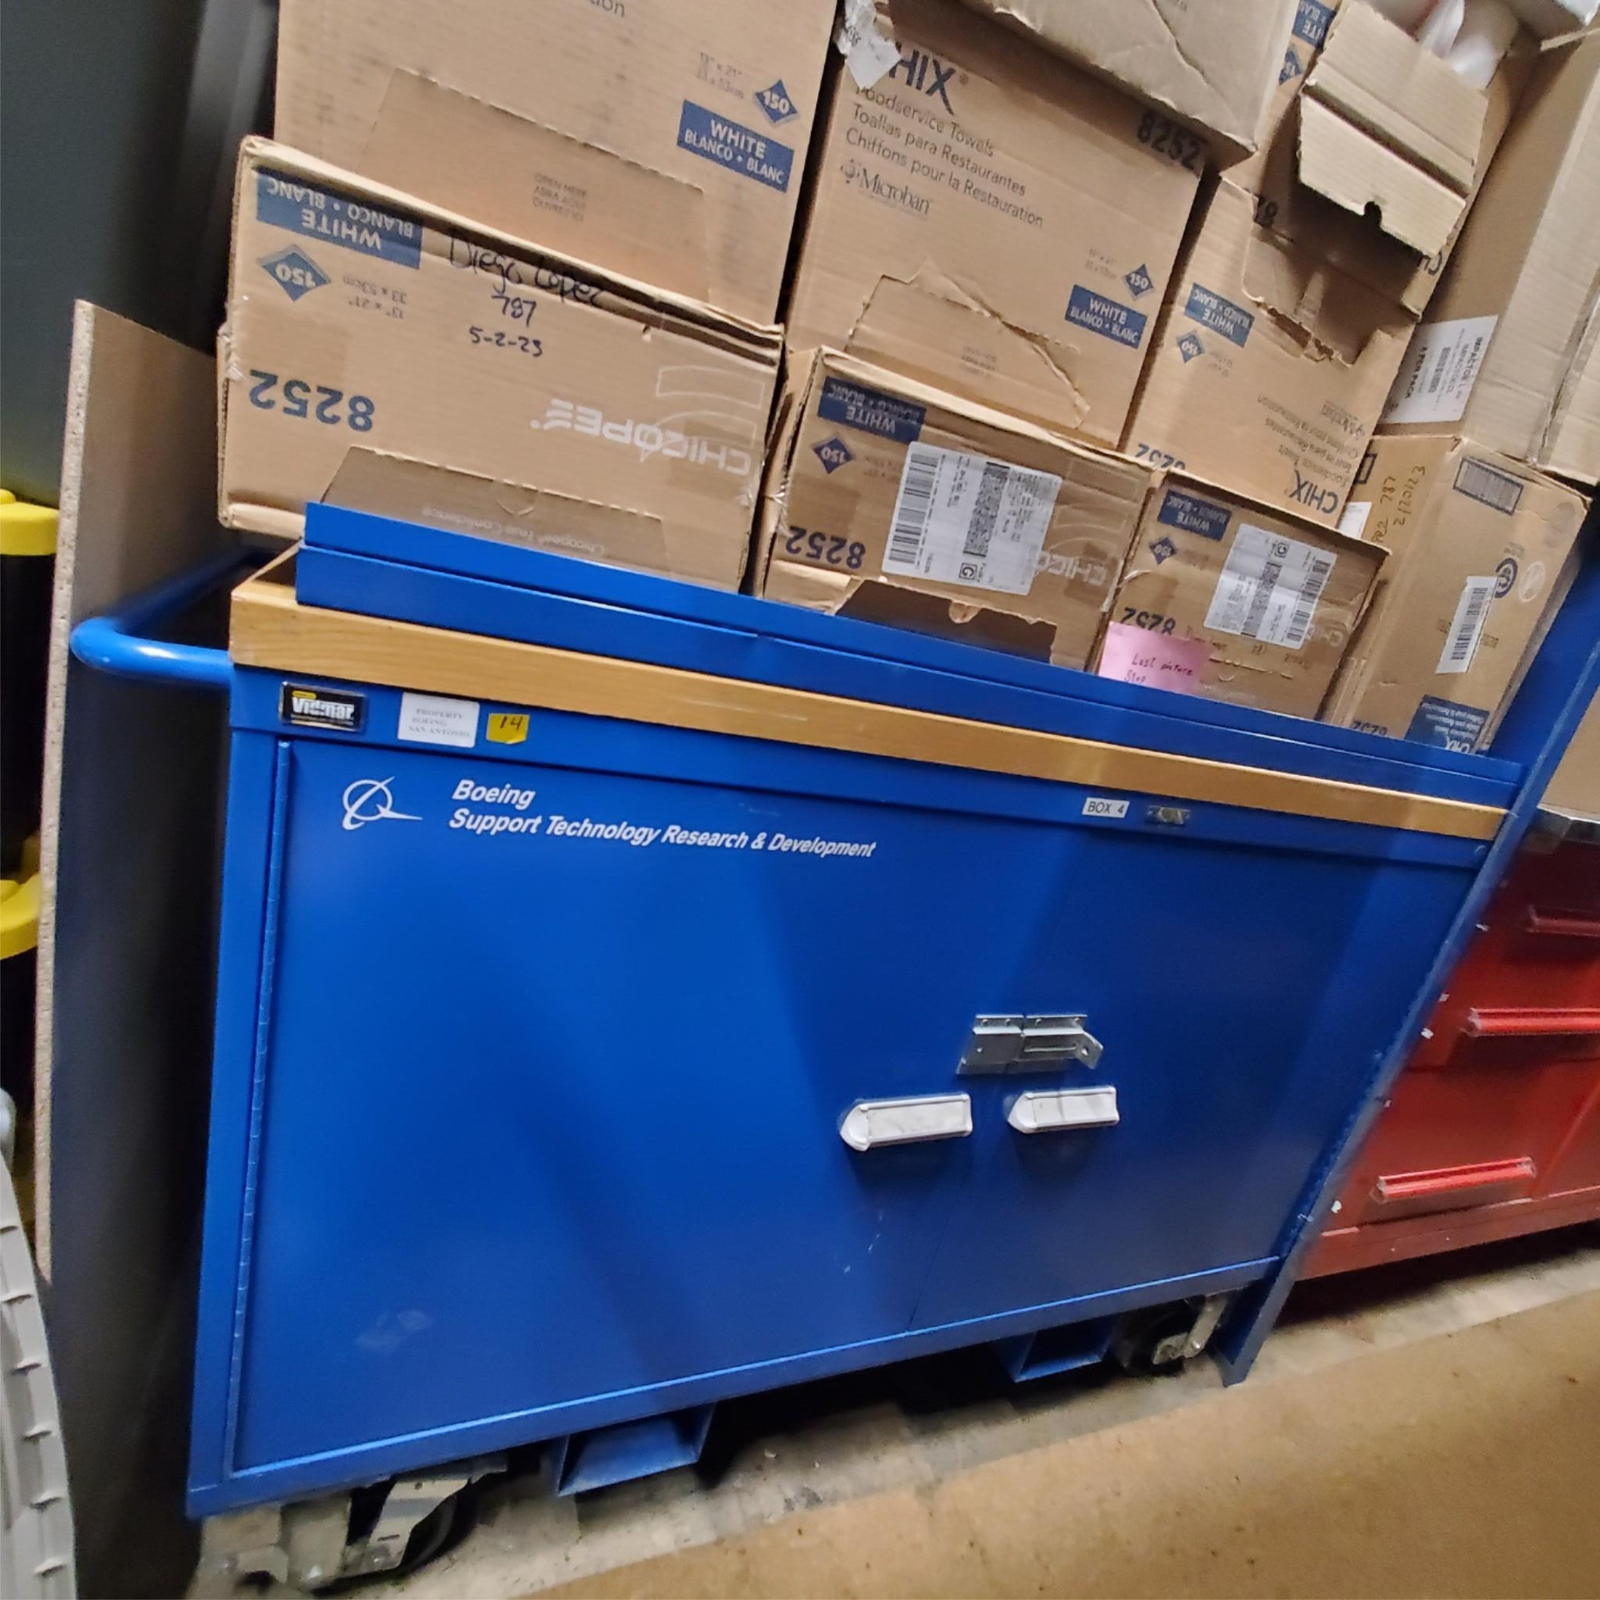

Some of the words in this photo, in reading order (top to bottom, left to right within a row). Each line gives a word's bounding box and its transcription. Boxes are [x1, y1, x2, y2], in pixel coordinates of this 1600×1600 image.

[763, 89, 790, 115] 150
[710, 119, 768, 160] WHITE
[853, 103, 901, 139] Toallas
[905, 131, 938, 155] para
[941, 144, 1027, 196] Restaurantes
[950, 122, 994, 157] Towels
[1137, 109, 1208, 171] 8252
[684, 129, 733, 161] BLANCO
[746, 157, 785, 185] BLANC
[267, 176, 326, 209] BLANC
[846, 128, 908, 167] Chiffons
[911, 158, 945, 182] pour
[948, 171, 960, 191] la
[964, 179, 1044, 228] Restauration
[860, 167, 931, 215] Microban
[302, 208, 382, 250] WHITE
[347, 203, 414, 238] BLANCO
[275, 263, 316, 287] 150
[1130, 273, 1149, 289] 150
[491, 295, 537, 327] 787
[1070, 306, 1103, 328] BLANCO
[1111, 323, 1139, 343] BLANC
[1090, 297, 1127, 325] WHITE
[1202, 308, 1235, 335] WHITE
[469, 326, 543, 357] 5-2-23
[249, 369, 375, 432] 8252
[846, 406, 896, 433] WHITE
[541, 398, 751, 476] CHICOPEE
[820, 447, 845, 464] 150
[1288, 469, 1339, 514] CHIX
[1380, 476, 1396, 504] 787
[785, 526, 866, 570] 8252
[292, 696, 355, 721] Vidmar
[500, 716, 523, 731] 14
[452, 780, 536, 809] Boeing
[1087, 800, 1112, 814] BOX
[1117, 804, 1125, 814] 4
[450, 808, 542, 836] Support
[545, 815, 661, 847] Technology
[661, 825, 750, 850] Research
[750, 833, 765, 849] &
[768, 834, 877, 858] Development
